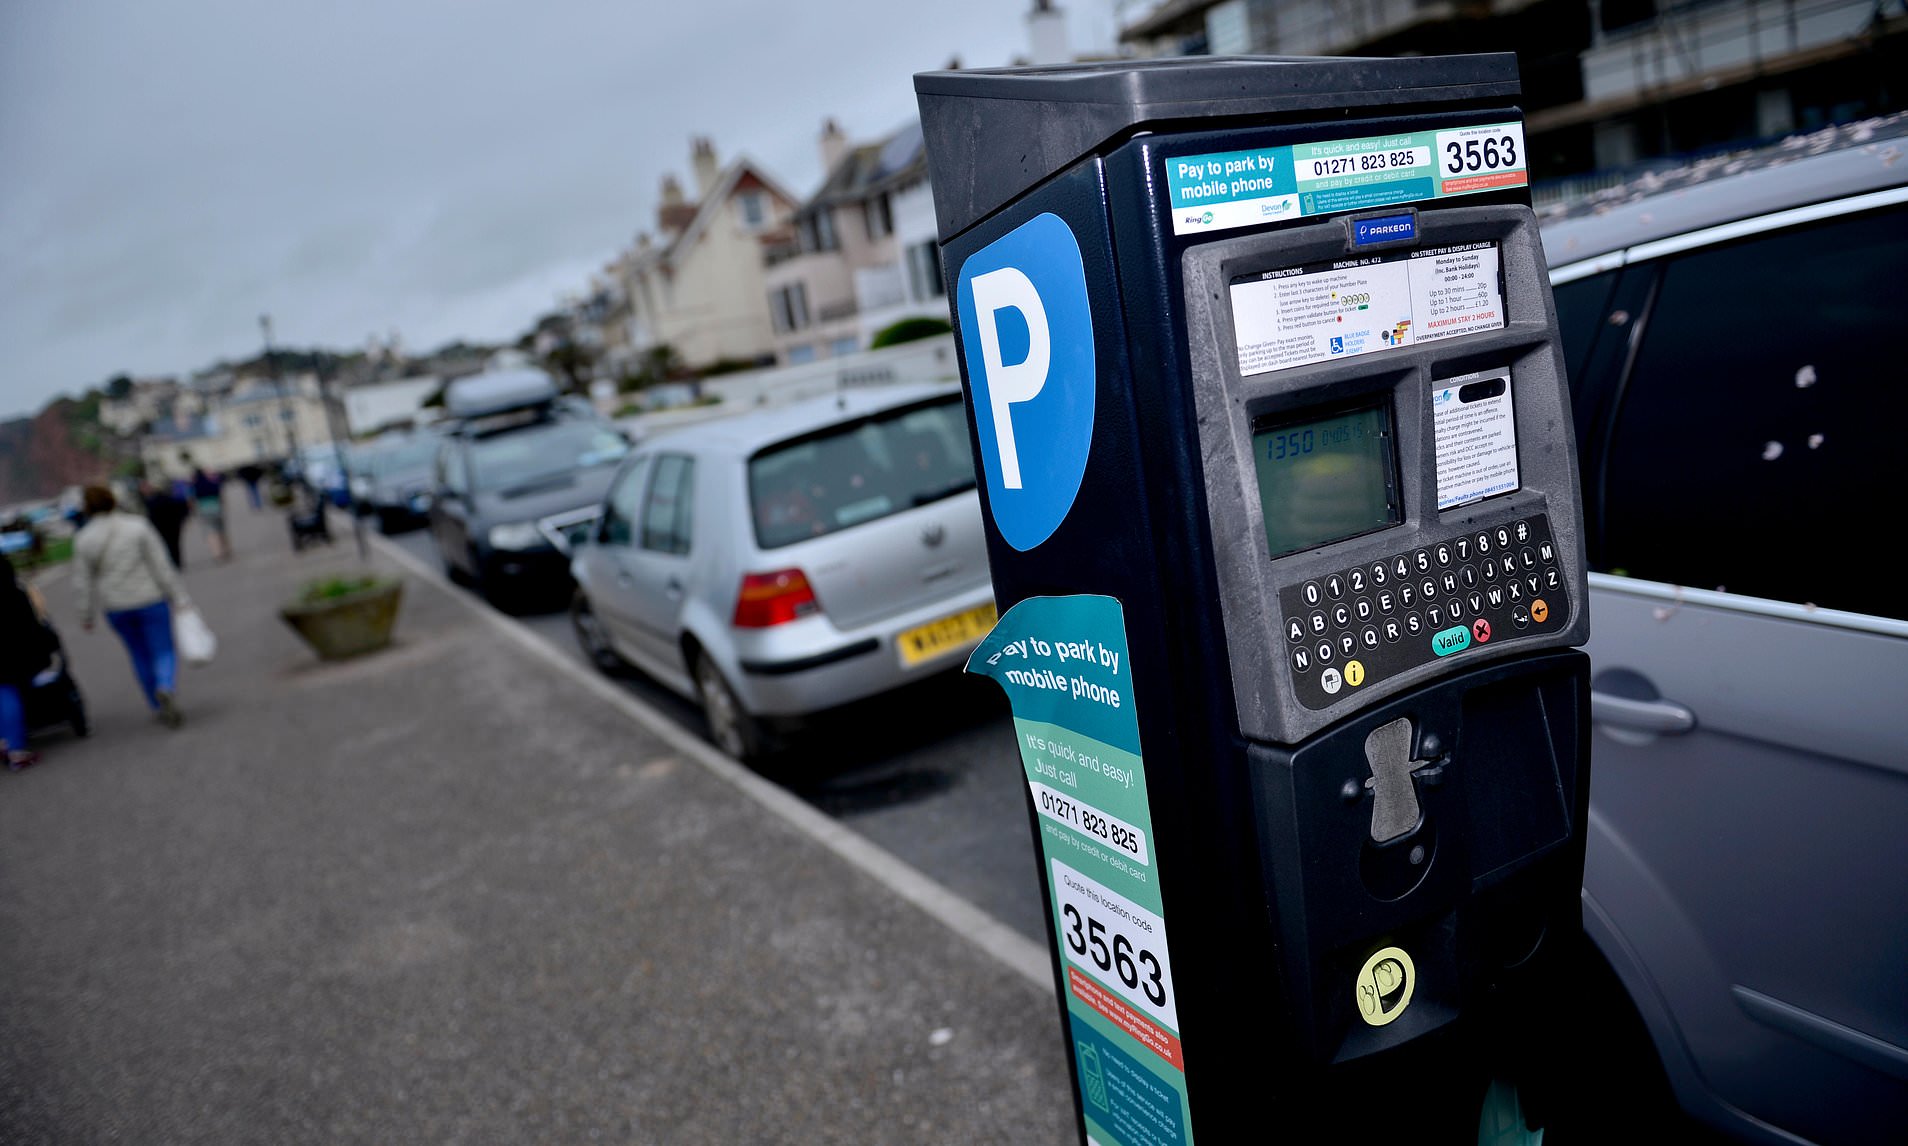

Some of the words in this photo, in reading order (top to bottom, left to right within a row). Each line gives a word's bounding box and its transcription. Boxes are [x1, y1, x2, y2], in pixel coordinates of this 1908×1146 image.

[1324, 144, 1344, 155] quick
[1346, 142, 1360, 151] and
[1383, 138, 1398, 148] Just
[1400, 136, 1412, 146] call
[1446, 135, 1516, 174] 3563
[1178, 163, 1204, 180] Pay
[1207, 161, 1221, 176] to
[1225, 156, 1255, 176] park
[1258, 155, 1274, 172] by
[1314, 157, 1356, 176] 01271
[1361, 154, 1386, 171] 823
[1390, 150, 1415, 167] 825
[1181, 180, 1227, 199] mobile
[1231, 177, 1273, 197] phone
[1316, 181, 1328, 189] and
[1330, 178, 1343, 188] pay
[1344, 176, 1353, 186] by
[1354, 174, 1373, 184] credit
[1384, 171, 1400, 180] debit
[1401, 170, 1415, 178] card
[1261, 203, 1282, 212] Devon
[1370, 223, 1411, 236] PARKEON
[1420, 249, 1437, 257] STREET
[1452, 244, 1472, 253] DISPLAY
[1472, 241, 1491, 250] CHARGE
[1436, 256, 1455, 265] Monday
[1462, 253, 1479, 262] Sunday
[1262, 268, 1304, 280] INSTRUCTIONS
[1333, 260, 1359, 270] MACHINE
[1278, 282, 1289, 290] Press
[1430, 290, 1437, 298] Up
[1452, 286, 1465, 294] mins
[1430, 299, 1437, 307] Up
[1449, 295, 1462, 303] hour
[1478, 291, 1488, 299] 60p
[1430, 308, 1438, 316] Up
[1450, 304, 1465, 312] hours
[1428, 317, 1457, 329] MAXIMUM
[1457, 315, 1471, 324] STAY
[1476, 311, 1495, 320] HOURS
[1416, 331, 1446, 341] OVERPAYMENT
[970, 266, 1051, 489] P
[1267, 429, 1313, 460] 1350
[1306, 585, 1318, 603] 0
[1352, 572, 1364, 590] 2
[1374, 565, 1385, 583] 3
[1397, 559, 1407, 576] 4
[1418, 552, 1428, 570] 5
[1438, 547, 1449, 564] 6
[1458, 541, 1467, 558] 7
[1479, 535, 1489, 552] 8
[1498, 530, 1508, 546] 9
[1517, 523, 1527, 541] #
[1291, 622, 1303, 639] A
[1312, 615, 1325, 631] B
[1336, 608, 1347, 624] C
[1358, 601, 1370, 617] D
[1380, 594, 1392, 610] E
[1402, 588, 1411, 603] F
[1423, 582, 1435, 596] G
[1444, 575, 1455, 590] H
[1504, 557, 1515, 572] K
[1523, 552, 1533, 565] L
[1541, 545, 1553, 560] M
[1295, 651, 1308, 668] N
[1319, 644, 1331, 660] O
[1342, 637, 1353, 653] P
[1364, 630, 1378, 645] Q
[1386, 623, 1399, 639] R
[1409, 616, 1419, 631] S
[1429, 609, 1439, 624] T
[1450, 602, 1461, 618] U
[1470, 596, 1479, 611] V
[1488, 589, 1501, 605] W
[1509, 583, 1520, 598] X
[1528, 577, 1537, 591] Y
[1548, 571, 1558, 586] Z
[1438, 632, 1465, 650] Valid
[986, 639, 1028, 666] Pay
[1030, 636, 1051, 656] to
[1055, 640, 1096, 664] park
[1099, 642, 1119, 675] by
[1005, 668, 1068, 692] mobile
[1071, 676, 1120, 708] phone
[1026, 734, 1046, 752] It's
[1048, 740, 1076, 762] quick
[1078, 751, 1100, 773] and
[1103, 763, 1134, 788] easy!
[1035, 758, 1058, 782] Just
[1059, 769, 1078, 788] call
[1041, 791, 1079, 824] 01271
[1083, 810, 1108, 839] 823
[1111, 824, 1138, 854] 825
[1045, 824, 1058, 836] and
[1059, 832, 1070, 845] pay
[1071, 834, 1080, 850] by
[1080, 843, 1100, 859] credit
[1100, 853, 1108, 862] or
[1110, 856, 1128, 874] debit
[1129, 868, 1146, 882] card
[1064, 874, 1086, 894] Quote
[1086, 888, 1100, 903] this
[1100, 895, 1131, 921] location
[1132, 916, 1152, 934] code
[1063, 903, 1167, 1008] 3563
[1103, 994, 1114, 1006] and
[1126, 1010, 1154, 1035] payments
[1155, 1030, 1169, 1044] also
